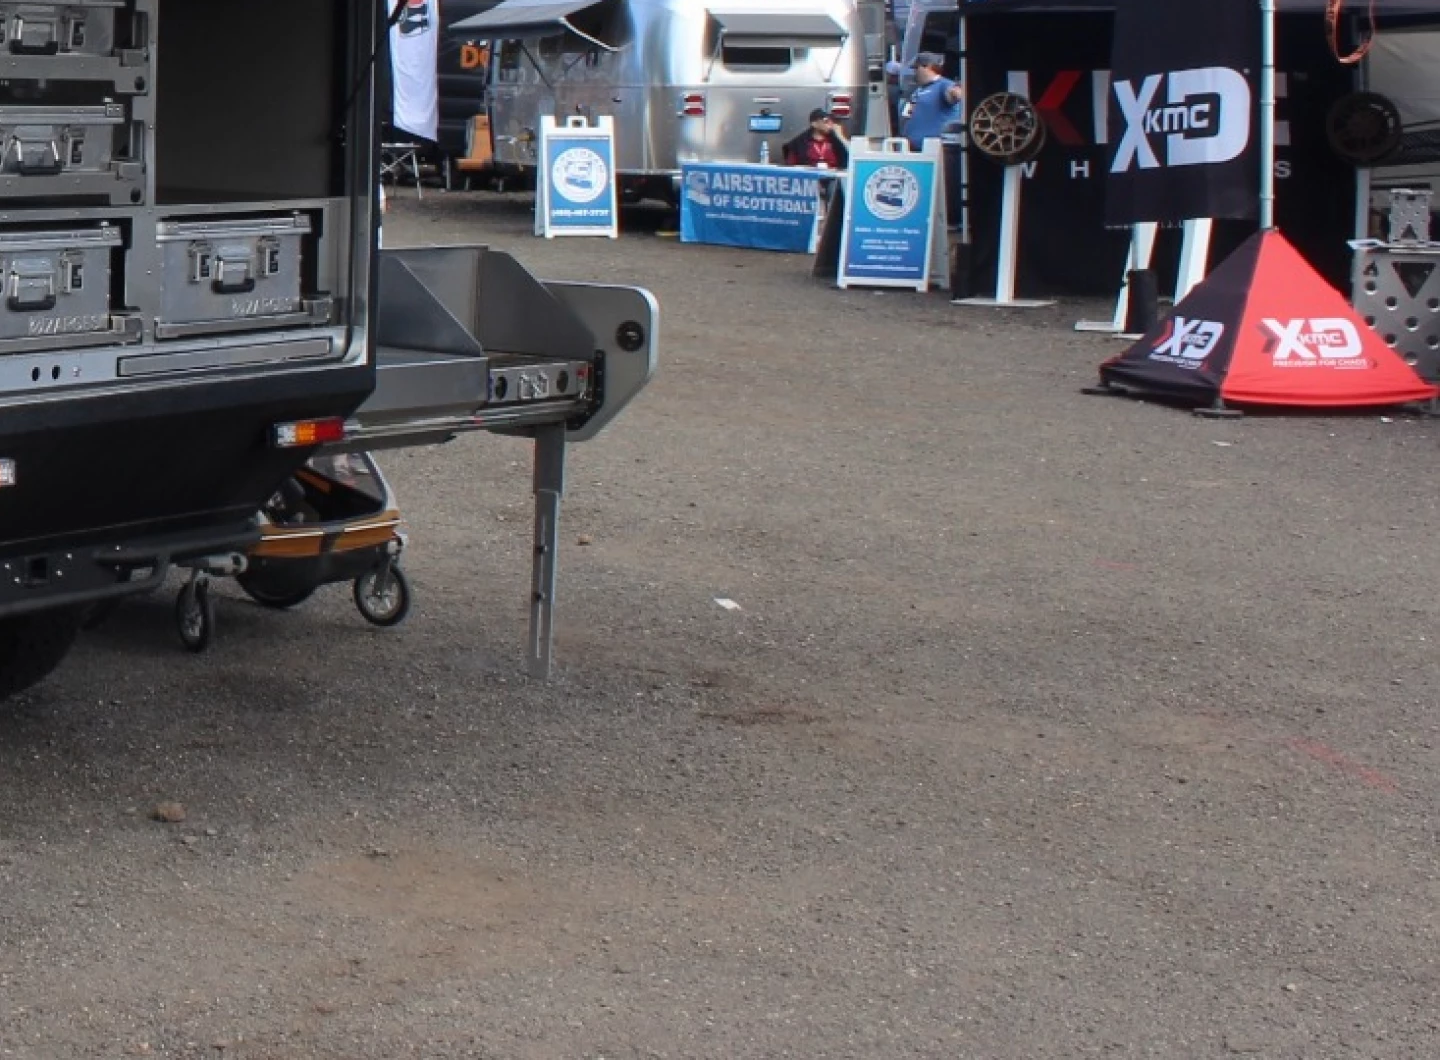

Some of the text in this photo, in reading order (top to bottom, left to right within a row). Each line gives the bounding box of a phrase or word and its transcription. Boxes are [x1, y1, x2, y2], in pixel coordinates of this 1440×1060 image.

[1110, 66, 1250, 173] XD
[712, 172, 818, 197] AIRSTREAM
[712, 194, 731, 208] OF
[1262, 317, 1363, 359] XD
